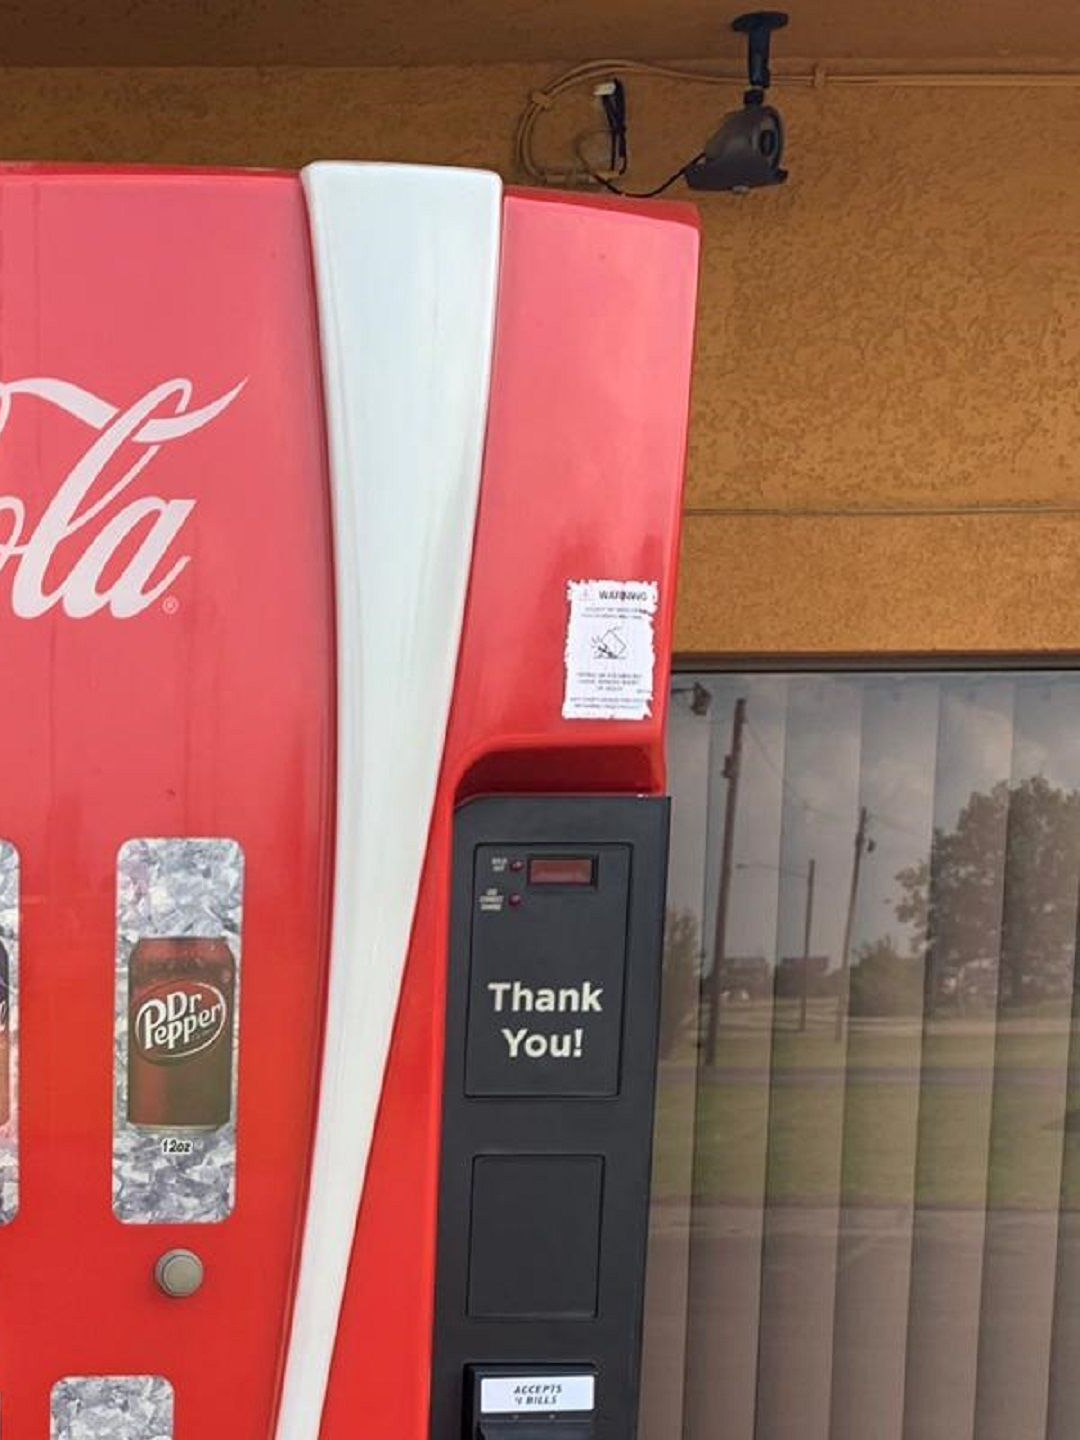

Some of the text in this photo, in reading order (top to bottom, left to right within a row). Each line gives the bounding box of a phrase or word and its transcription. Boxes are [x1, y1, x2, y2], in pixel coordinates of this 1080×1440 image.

[166, 991, 203, 1022] Dr
[487, 981, 603, 1013] Thank
[137, 998, 222, 1050] Pepper
[501, 1028, 584, 1058] You!
[513, 1383, 563, 1395] ACCEPTS
